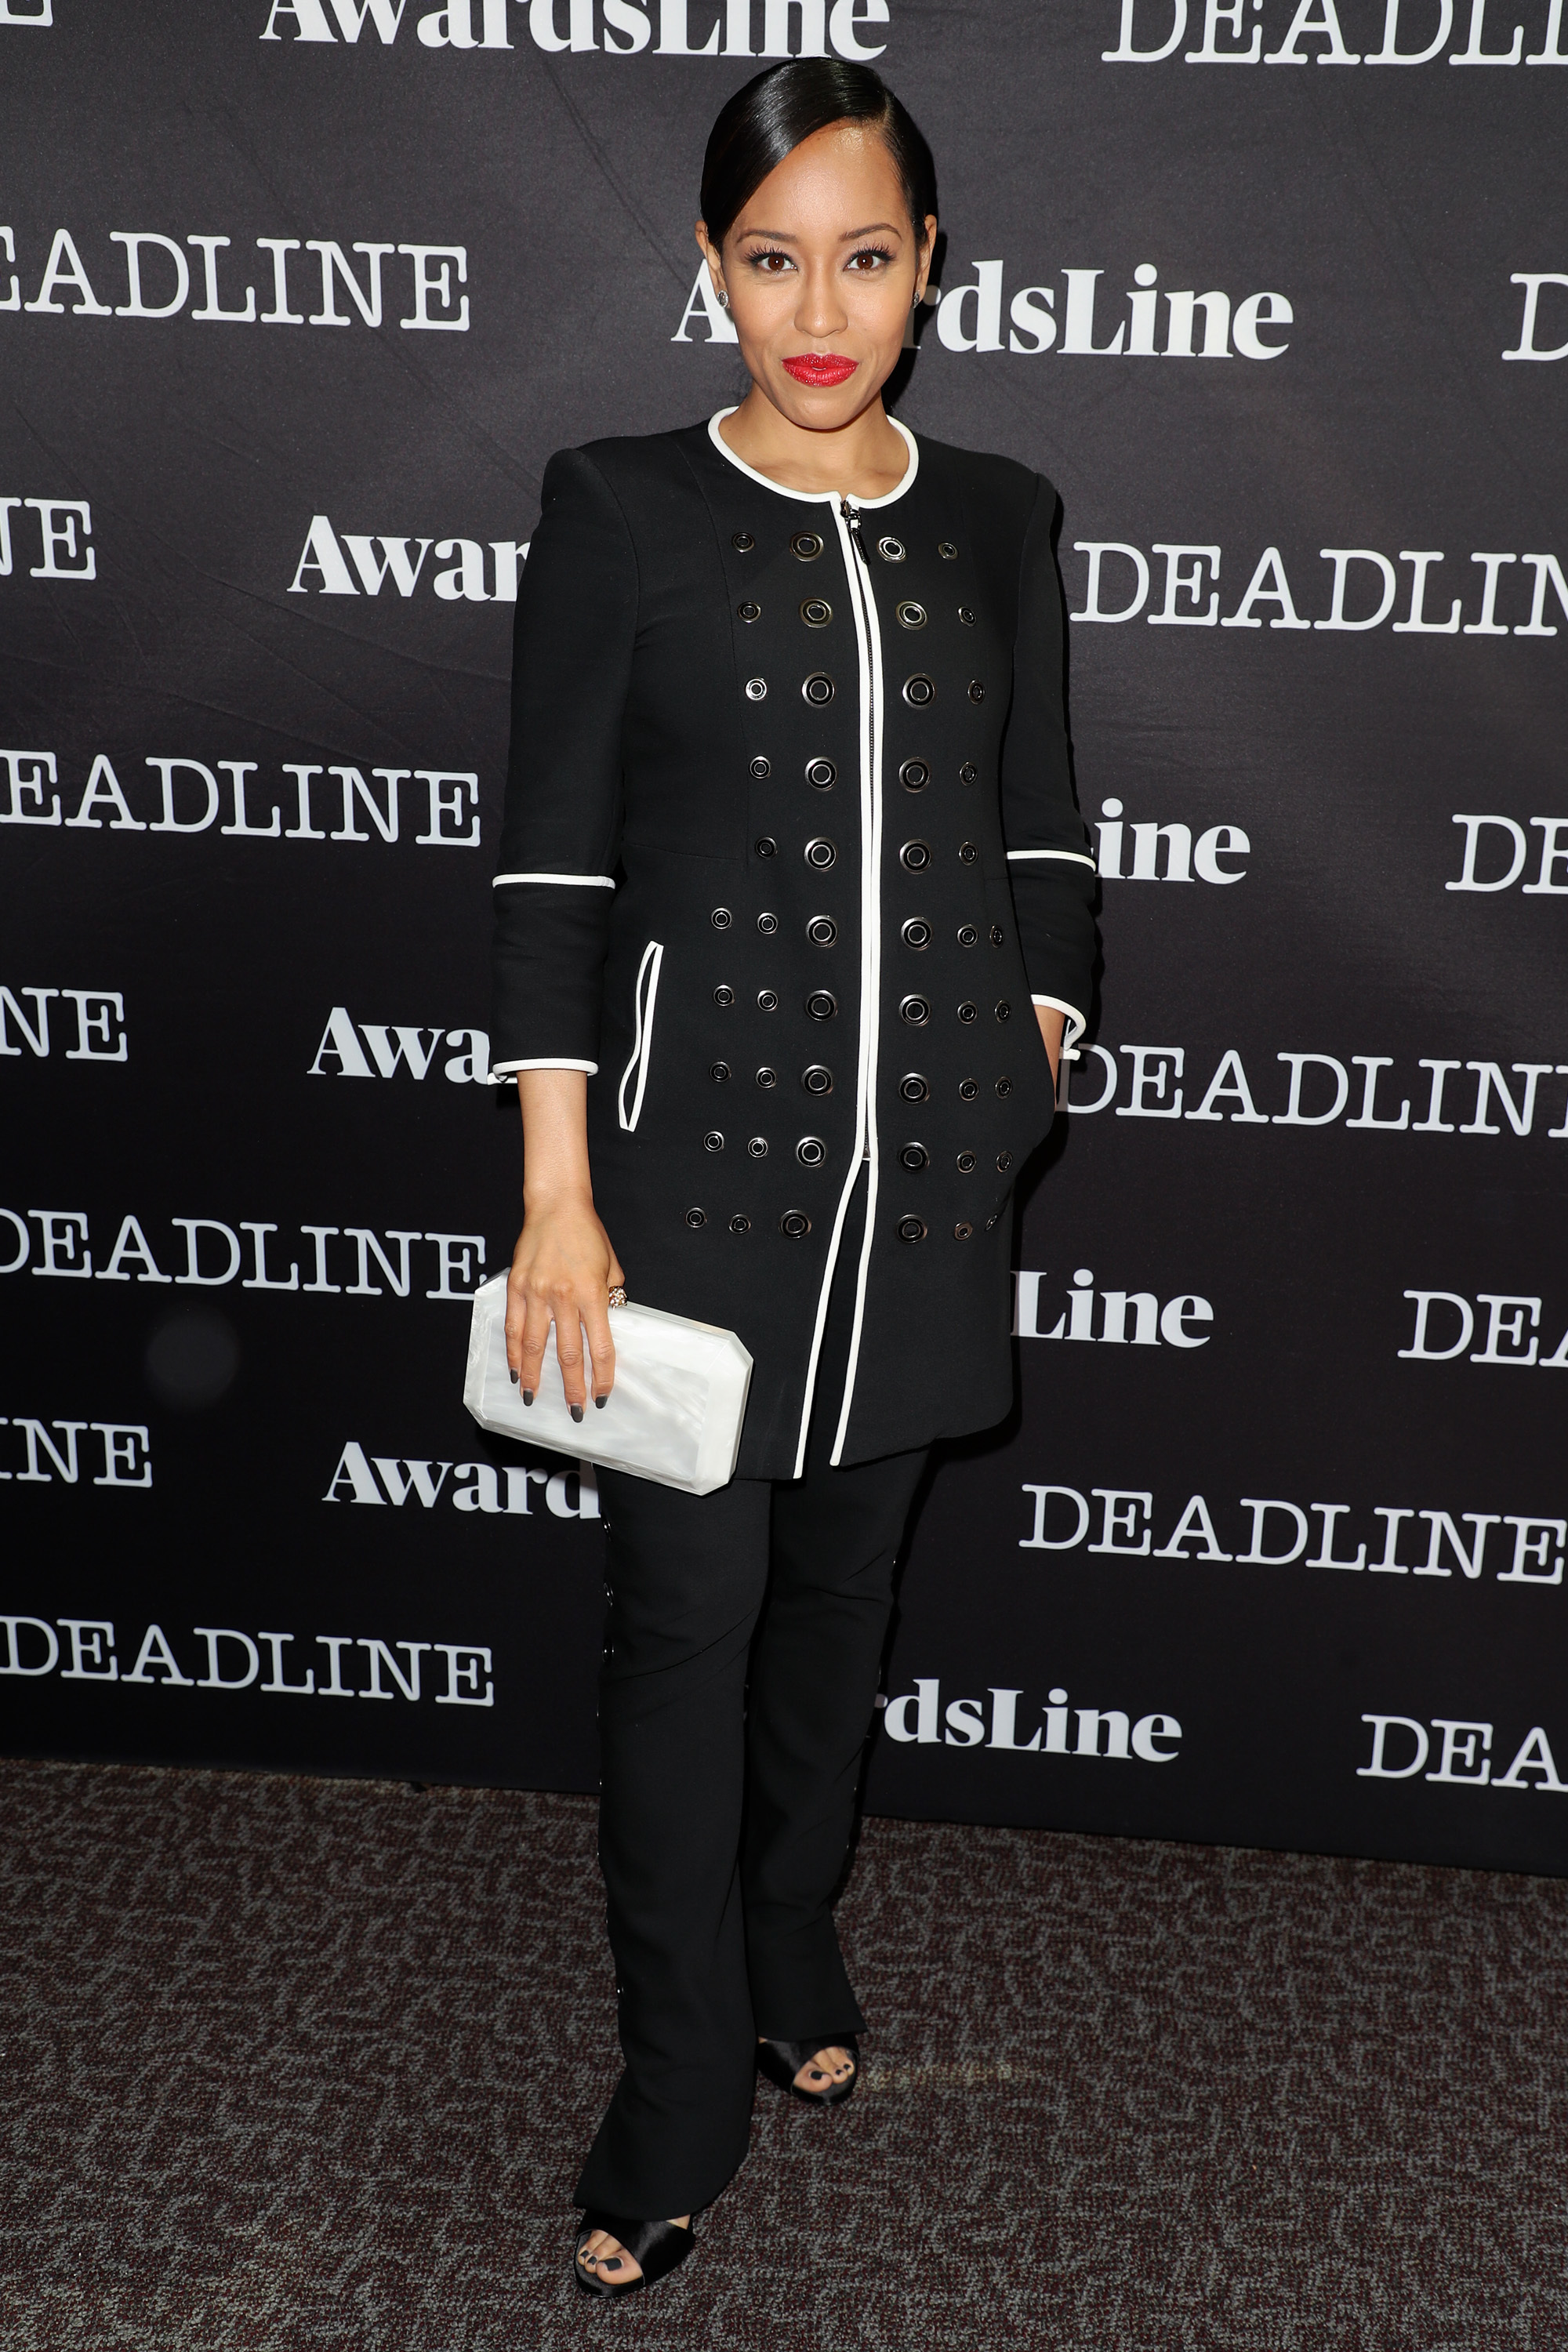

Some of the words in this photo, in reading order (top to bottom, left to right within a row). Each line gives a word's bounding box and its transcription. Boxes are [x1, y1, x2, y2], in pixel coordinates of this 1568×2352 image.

[0, 226, 470, 332] ADLINE
[1091, 798, 1250, 884] ine
[1054, 1043, 1568, 1138] DEADLIN
[0, 1417, 152, 1488] NE
[1019, 1484, 1567, 1585] DEADLINE
[0, 1615, 493, 1706] DEADLINE
[874, 1679, 1181, 1762] dsLine
